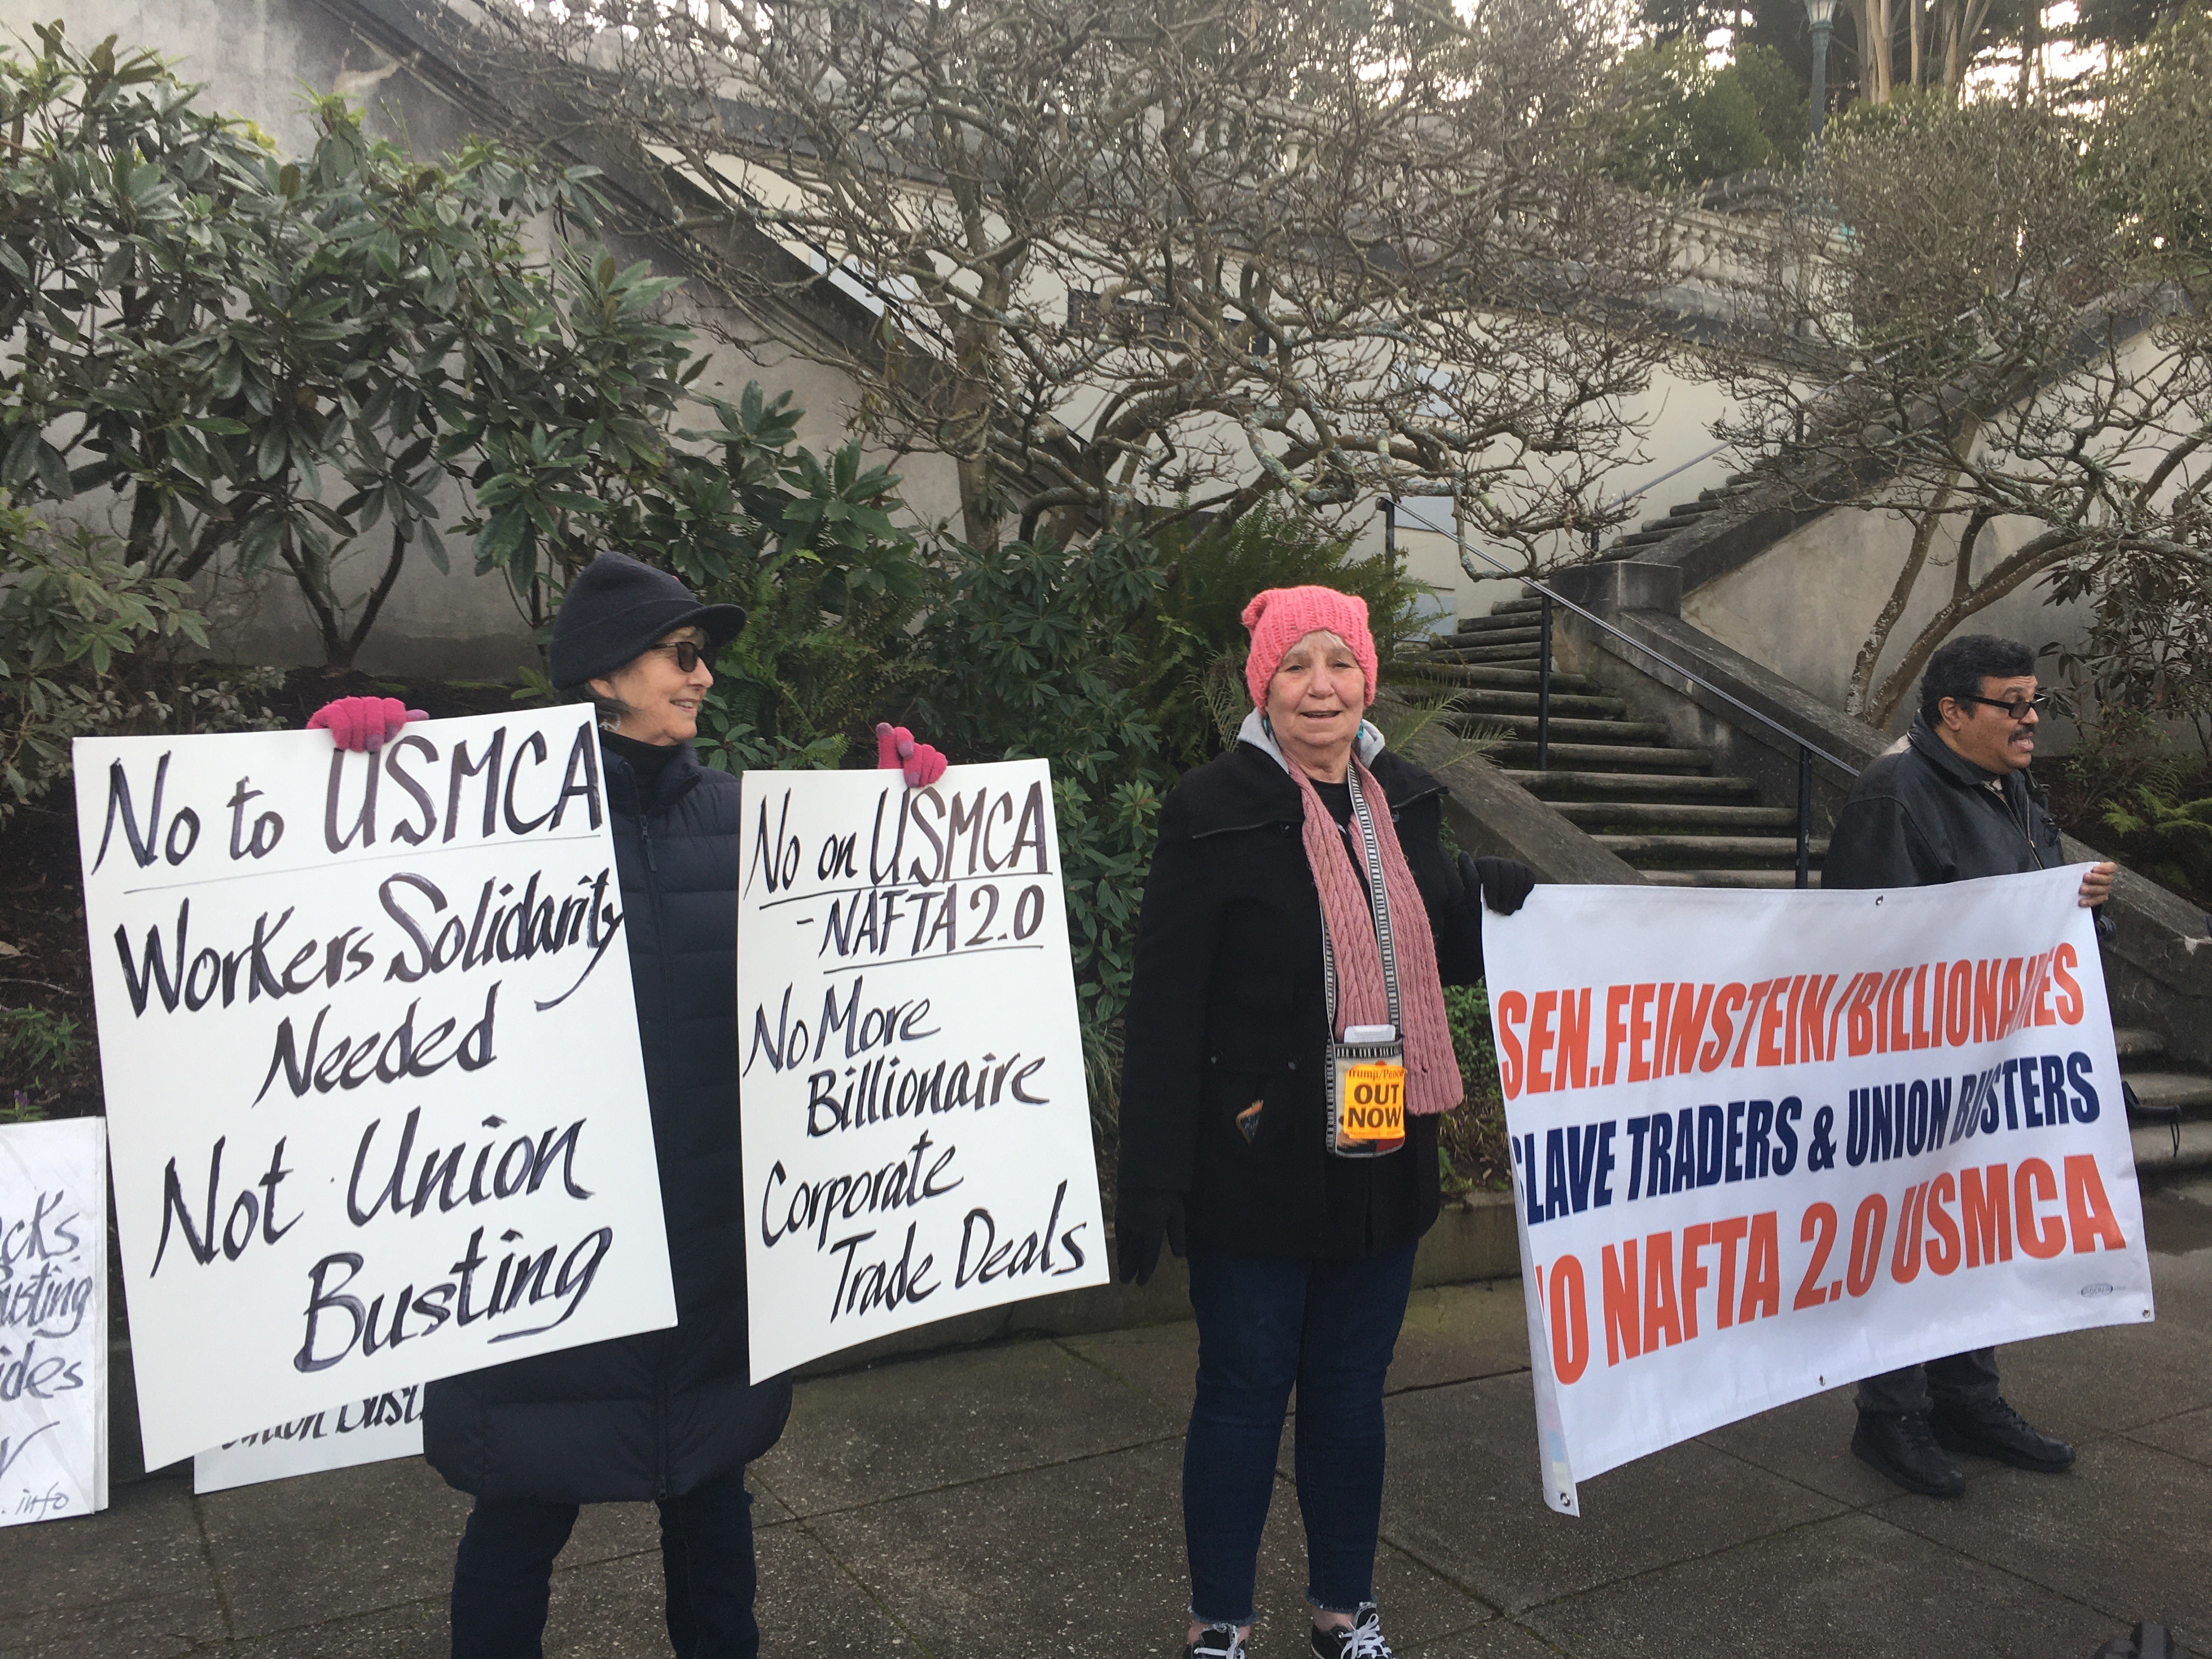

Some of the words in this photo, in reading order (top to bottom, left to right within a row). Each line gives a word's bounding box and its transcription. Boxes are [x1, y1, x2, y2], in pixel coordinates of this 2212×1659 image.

[91, 751, 200, 875] No
[227, 777, 285, 860] to
[324, 721, 602, 854] USMCA
[743, 787, 800, 900] No
[818, 832, 858, 881] on
[870, 780, 1048, 887] USMCA
[379, 866, 624, 1011] Solidarity
[964, 883, 1044, 946] 2.0
[252, 980, 503, 1108] Needed
[743, 981, 808, 1077] No
[812, 974, 941, 1059] More
[807, 1052, 1049, 1138] Billionaire
[1347, 1107, 1402, 1128] NOW
[1354, 1084, 1400, 1105] OUT
[1627, 1095, 1802, 1200] TRADERS
[1808, 1105, 1836, 1171] &
[1846, 1078, 1951, 1167] UNION
[1949, 1051, 2101, 1145] BUSTERS
[150, 1135, 303, 1278] Not
[347, 1106, 596, 1226] Union
[762, 1129, 963, 1252] Corporate
[829, 1220, 941, 1324] Trade
[955, 1179, 1087, 1289] Deals
[294, 1226, 613, 1373] Busting
[1535, 1254, 1590, 1385] O
[1601, 1211, 1780, 1368] NAFTA
[1793, 1193, 1889, 1311] 2.0
[1890, 1154, 2126, 1285] USMCA
